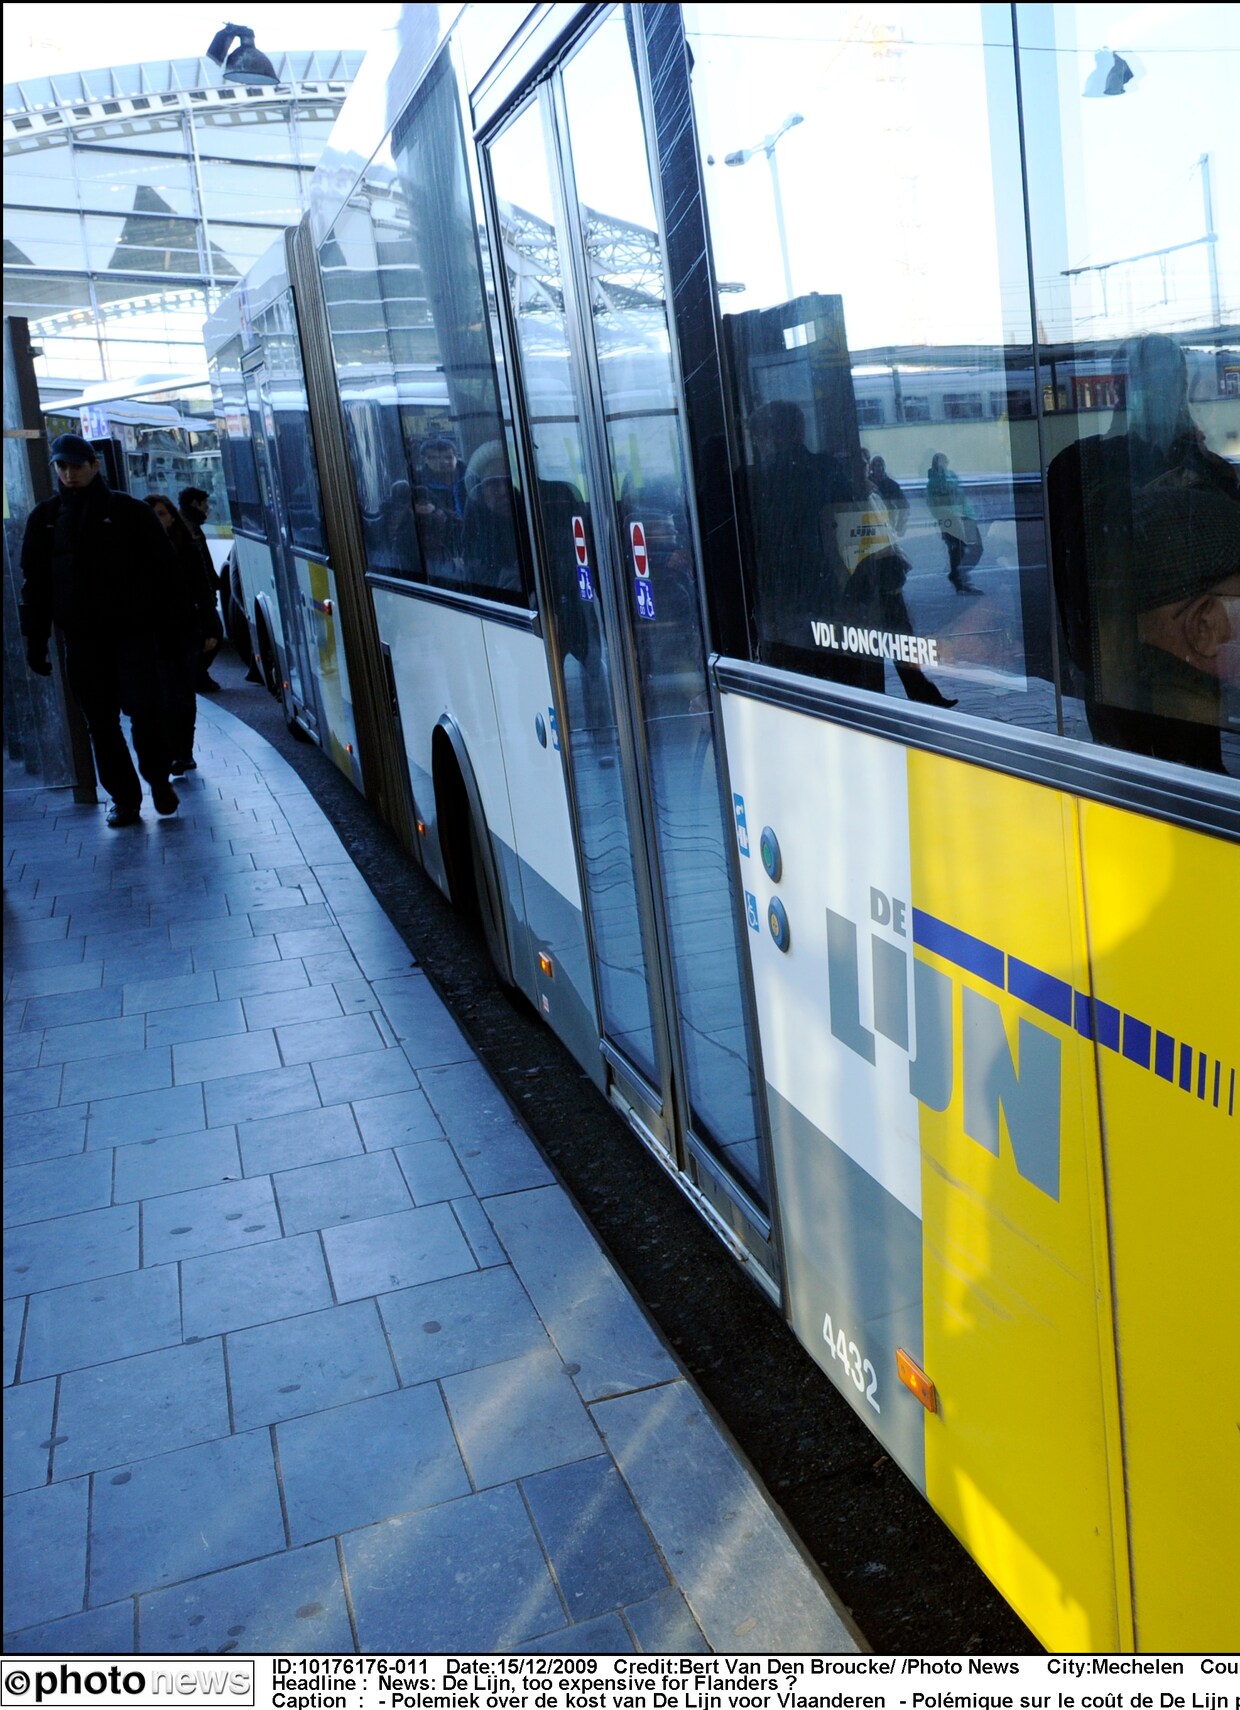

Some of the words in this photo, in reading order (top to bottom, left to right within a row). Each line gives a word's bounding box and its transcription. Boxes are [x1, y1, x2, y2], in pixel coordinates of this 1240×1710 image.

[811, 621, 839, 650] VDL
[841, 626, 938, 667] JONCKHEERE
[870, 886, 907, 938] DE
[826, 907, 1062, 1204] LIJN
[823, 1313, 880, 1414] 4432
